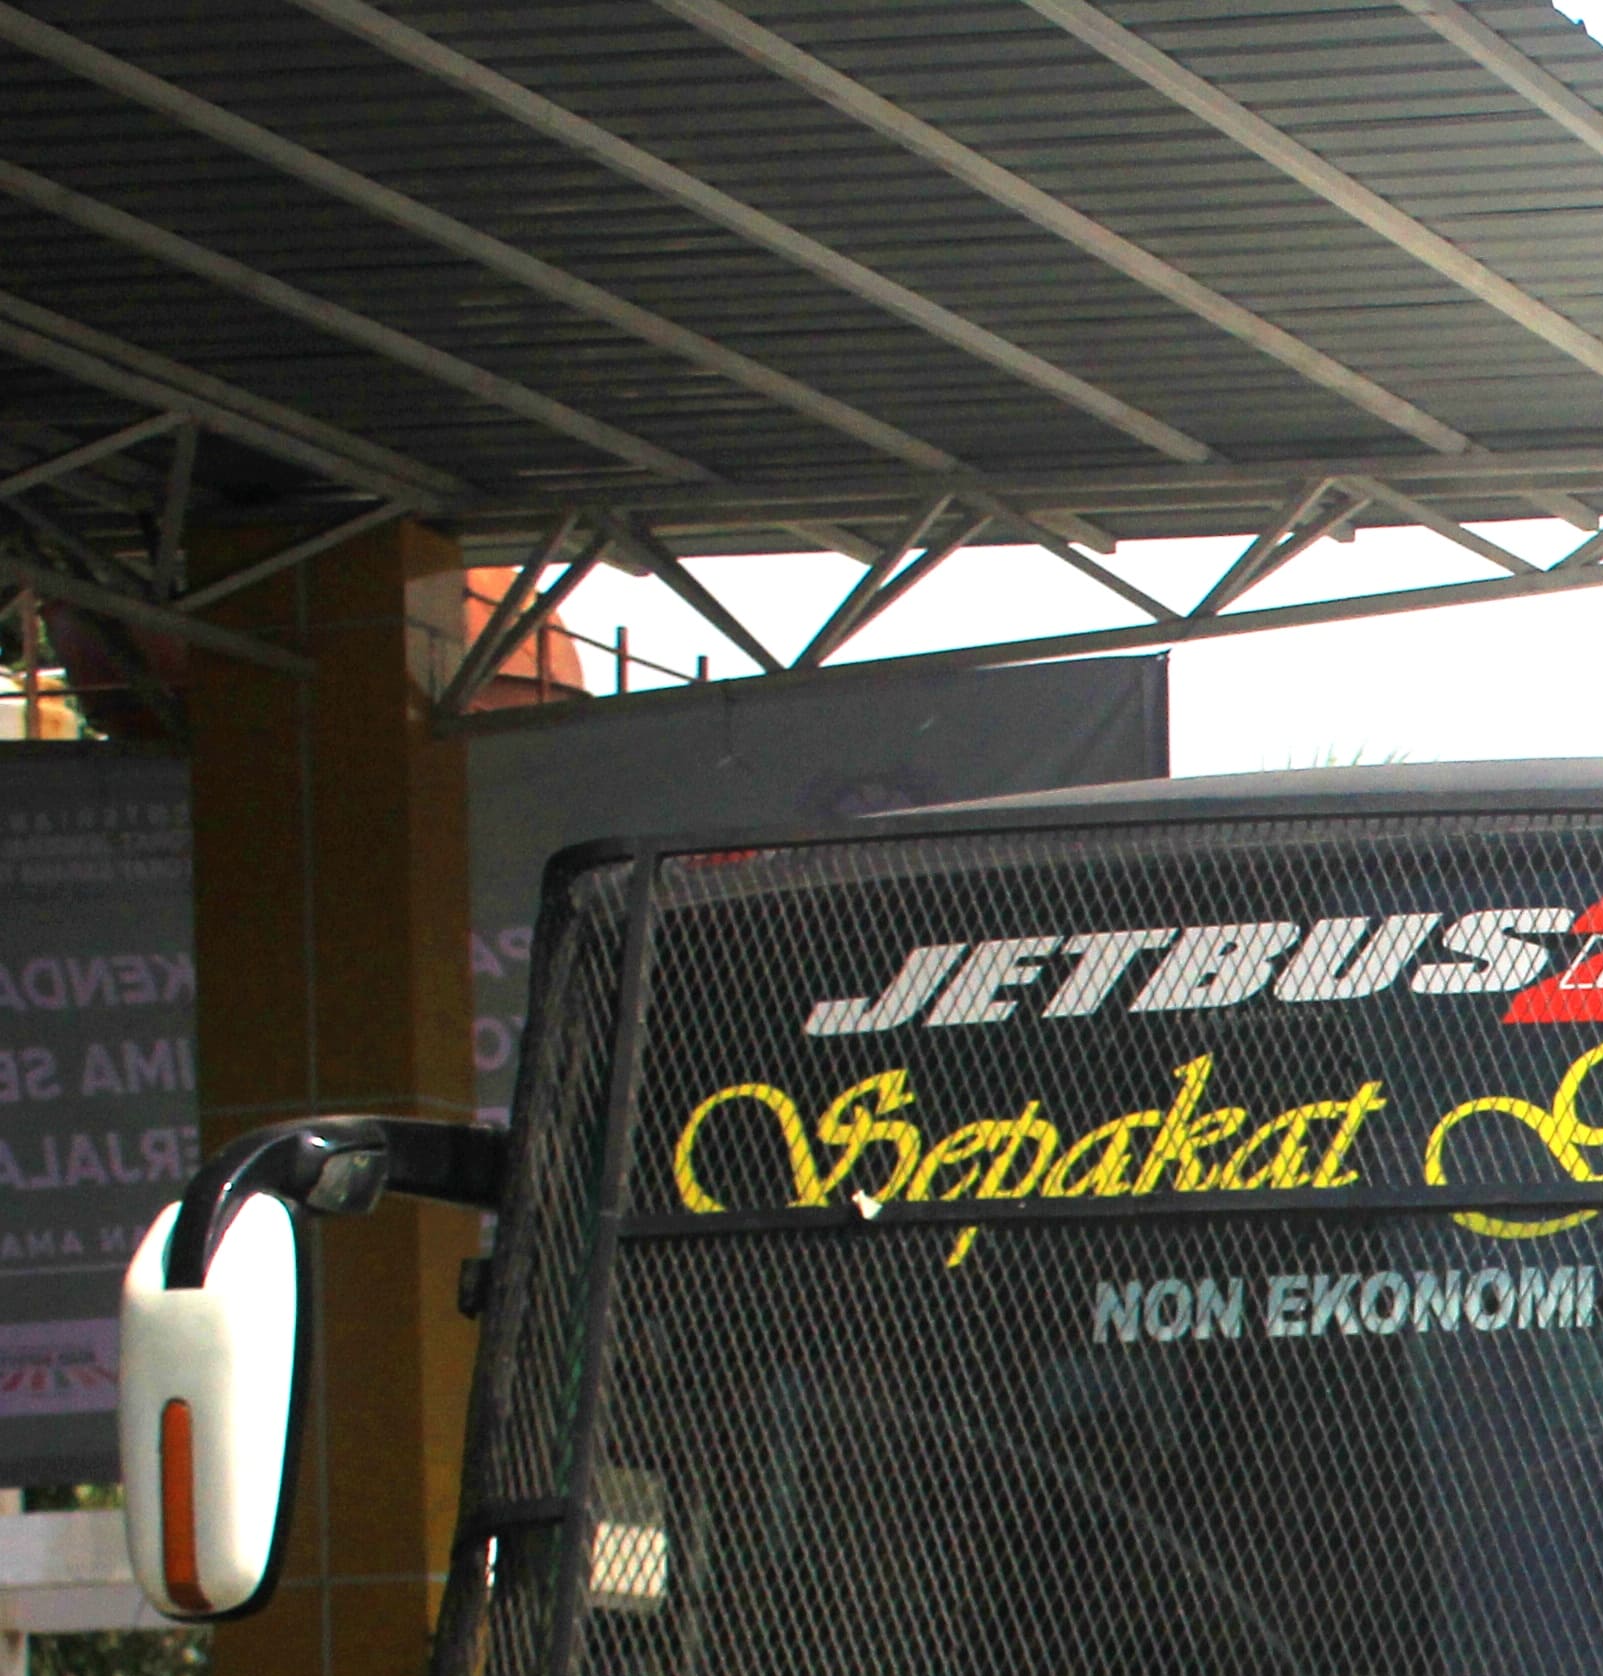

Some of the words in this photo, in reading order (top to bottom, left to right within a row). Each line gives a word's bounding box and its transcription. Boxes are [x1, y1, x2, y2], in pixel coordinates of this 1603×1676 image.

[805, 906, 1576, 1037] JETBUS
[673, 1052, 1388, 1268] Sepakat
[1093, 1277, 1244, 1343] NON
[1267, 1265, 1596, 1337] EKONOMI
